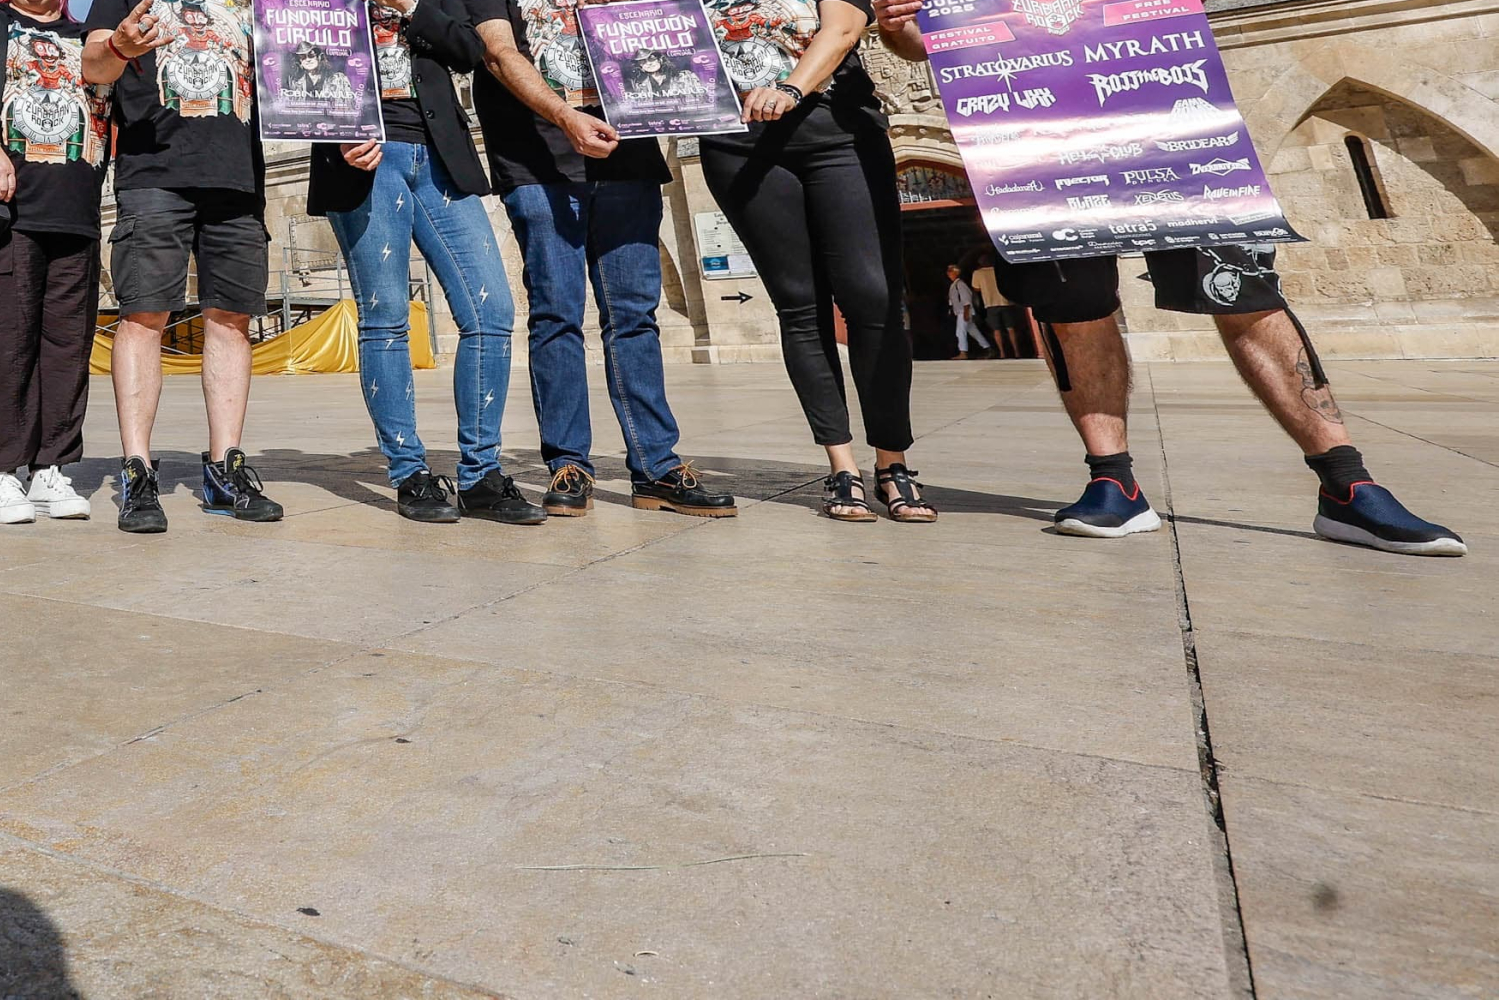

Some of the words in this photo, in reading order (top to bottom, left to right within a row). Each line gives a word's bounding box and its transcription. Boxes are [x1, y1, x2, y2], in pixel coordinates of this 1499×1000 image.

[266, 8, 358, 28] FUNDACIÓN
[618, 8, 663, 20] ESCENARIO
[928, 3, 975, 18] 2025
[1122, 6, 1189, 20] FESTIVAL
[596, 14, 698, 39] FUNDACIÓN
[930, 26, 992, 41] FESTIVAL
[932, 35, 996, 50] GRATUITO
[1083, 30, 1206, 63] MYRATH
[940, 50, 1074, 85] STRATOVARIUS
[956, 92, 1010, 117] CRAZY
[1012, 87, 1057, 110] LIXX
[1162, 134, 1234, 151] BRIDEAR
[1120, 167, 1182, 184] PULSA
[1108, 219, 1158, 235] tetra5
[1166, 216, 1219, 229] madhervi
